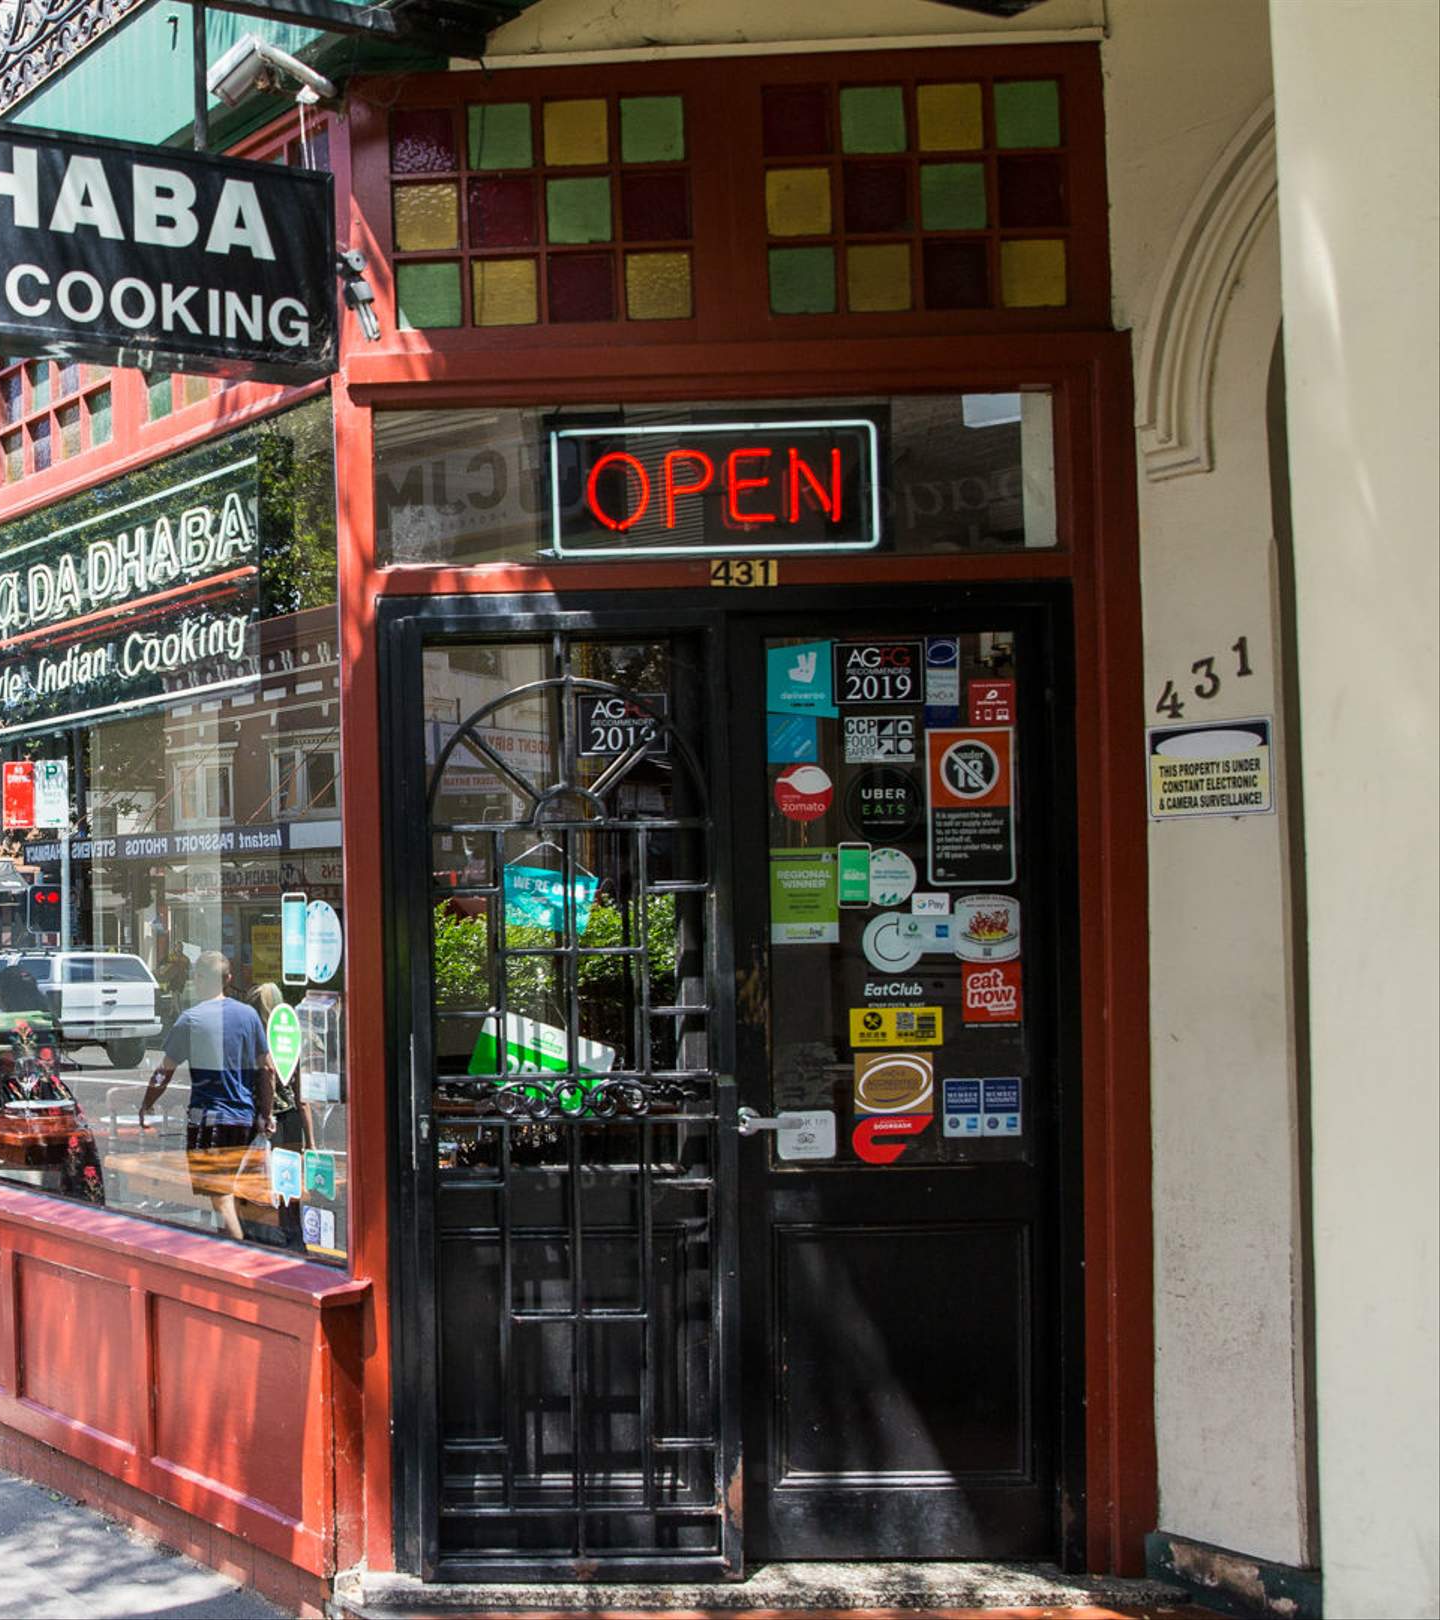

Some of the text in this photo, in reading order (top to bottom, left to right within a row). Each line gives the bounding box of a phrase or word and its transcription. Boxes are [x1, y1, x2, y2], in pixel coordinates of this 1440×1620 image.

[5, 263, 310, 347] COOKING
[587, 447, 842, 533] OPEN
[28, 554, 81, 621] DA
[88, 493, 254, 602] DHABA
[712, 560, 773, 587] 431
[36, 643, 106, 693] Indian
[123, 614, 249, 679] Cooking
[1156, 636, 1253, 719] 431
[779, 691, 826, 700] deliveroo
[845, 674, 912, 700] 2019
[846, 719, 877, 735] CCP
[952, 759, 985, 788] 18
[1159, 757, 1260, 777] THIS PROPERTY IS UNDER
[1162, 775, 1258, 794] CONSTANT ELECTRONIC
[861, 788, 907, 800] UBER
[1159, 792, 1262, 810] & CAMERA SURVEILLANCE!
[782, 801, 826, 813] zomato
[862, 803, 907, 816] EATS
[776, 870, 832, 880] REGIONAL
[782, 880, 827, 889] WINNER
[928, 901, 945, 912] Pay
[864, 982, 924, 997] EatClub
[969, 971, 1002, 990] eat
[969, 988, 1013, 1005] now
[873, 1122, 913, 1131] DOORDASH
